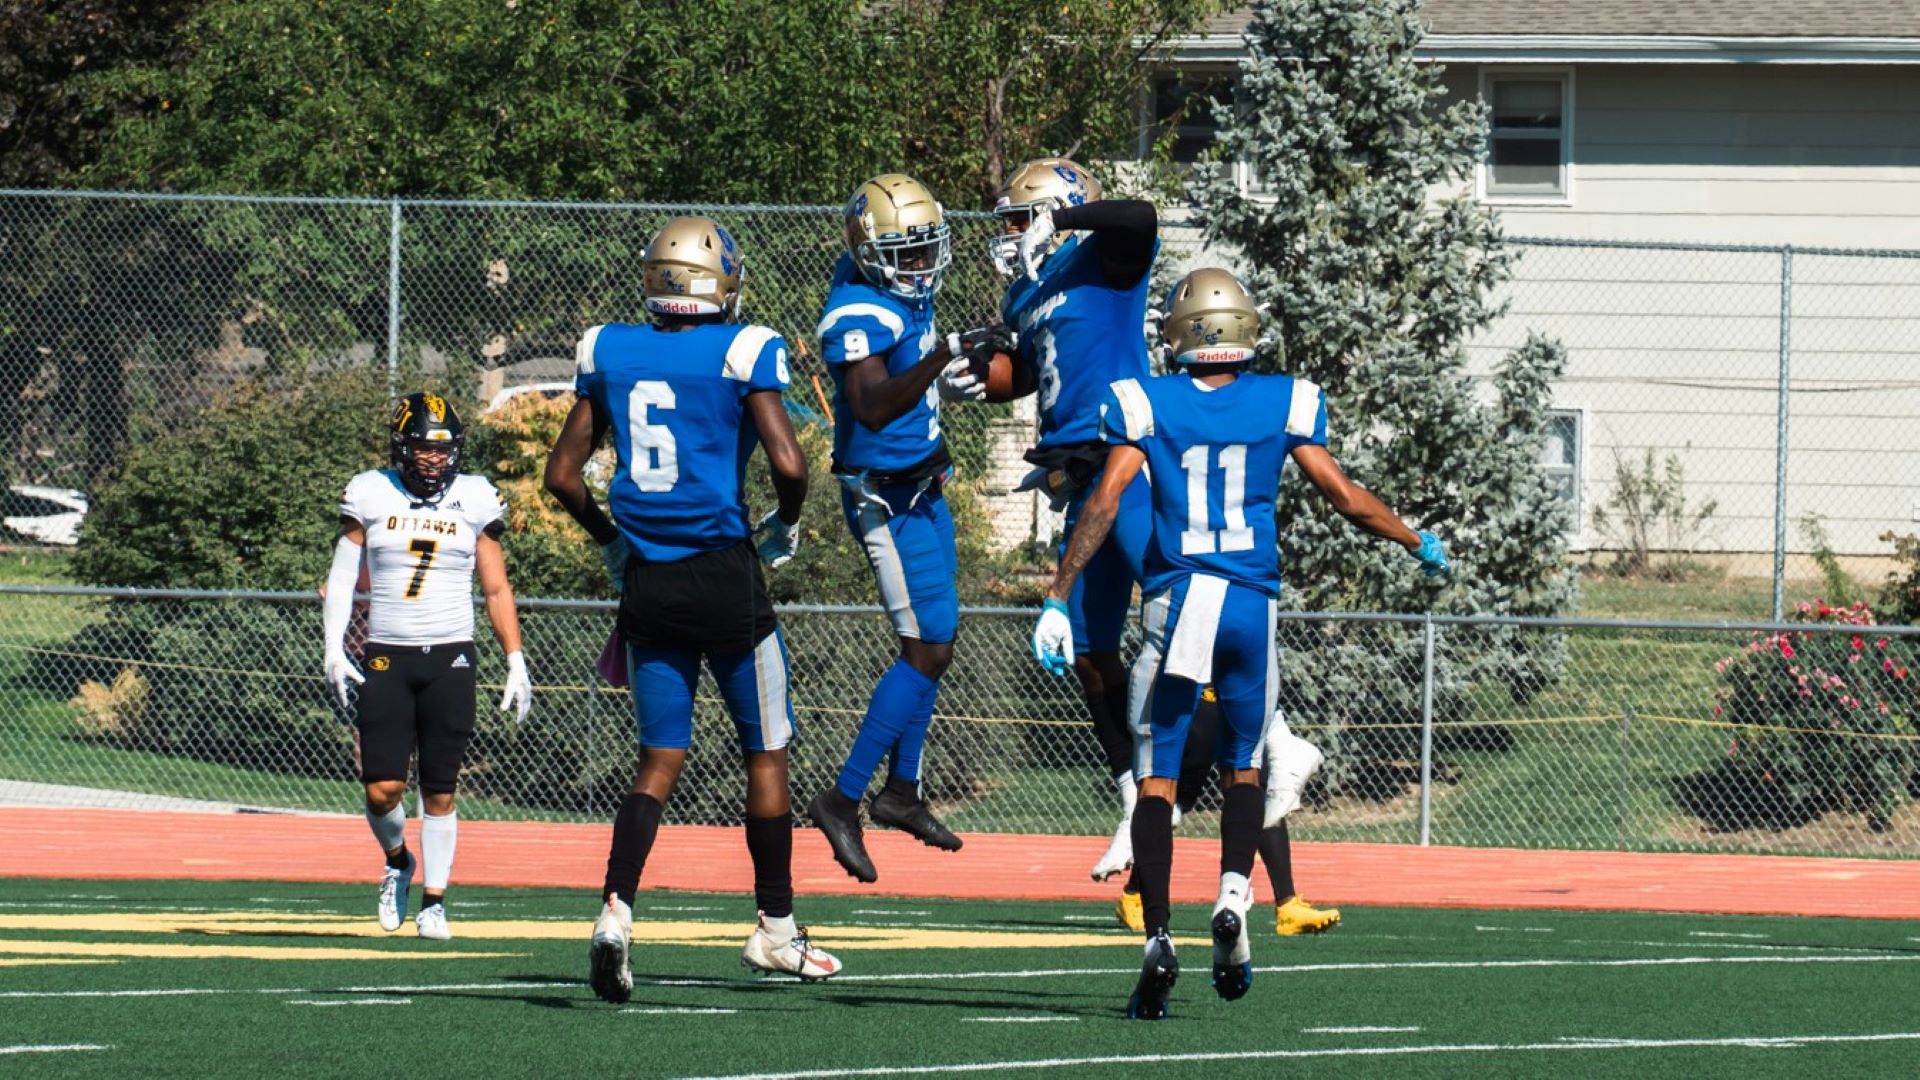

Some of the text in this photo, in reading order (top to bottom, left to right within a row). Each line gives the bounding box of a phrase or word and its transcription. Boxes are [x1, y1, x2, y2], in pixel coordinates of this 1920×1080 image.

[843, 329, 870, 362] 9
[1196, 350, 1244, 361] Riddell
[776, 347, 790, 384] 6
[628, 380, 679, 493] 6
[1180, 444, 1255, 555] 11
[387, 515, 458, 537] OTTAWA
[404, 539, 440, 602] 7
